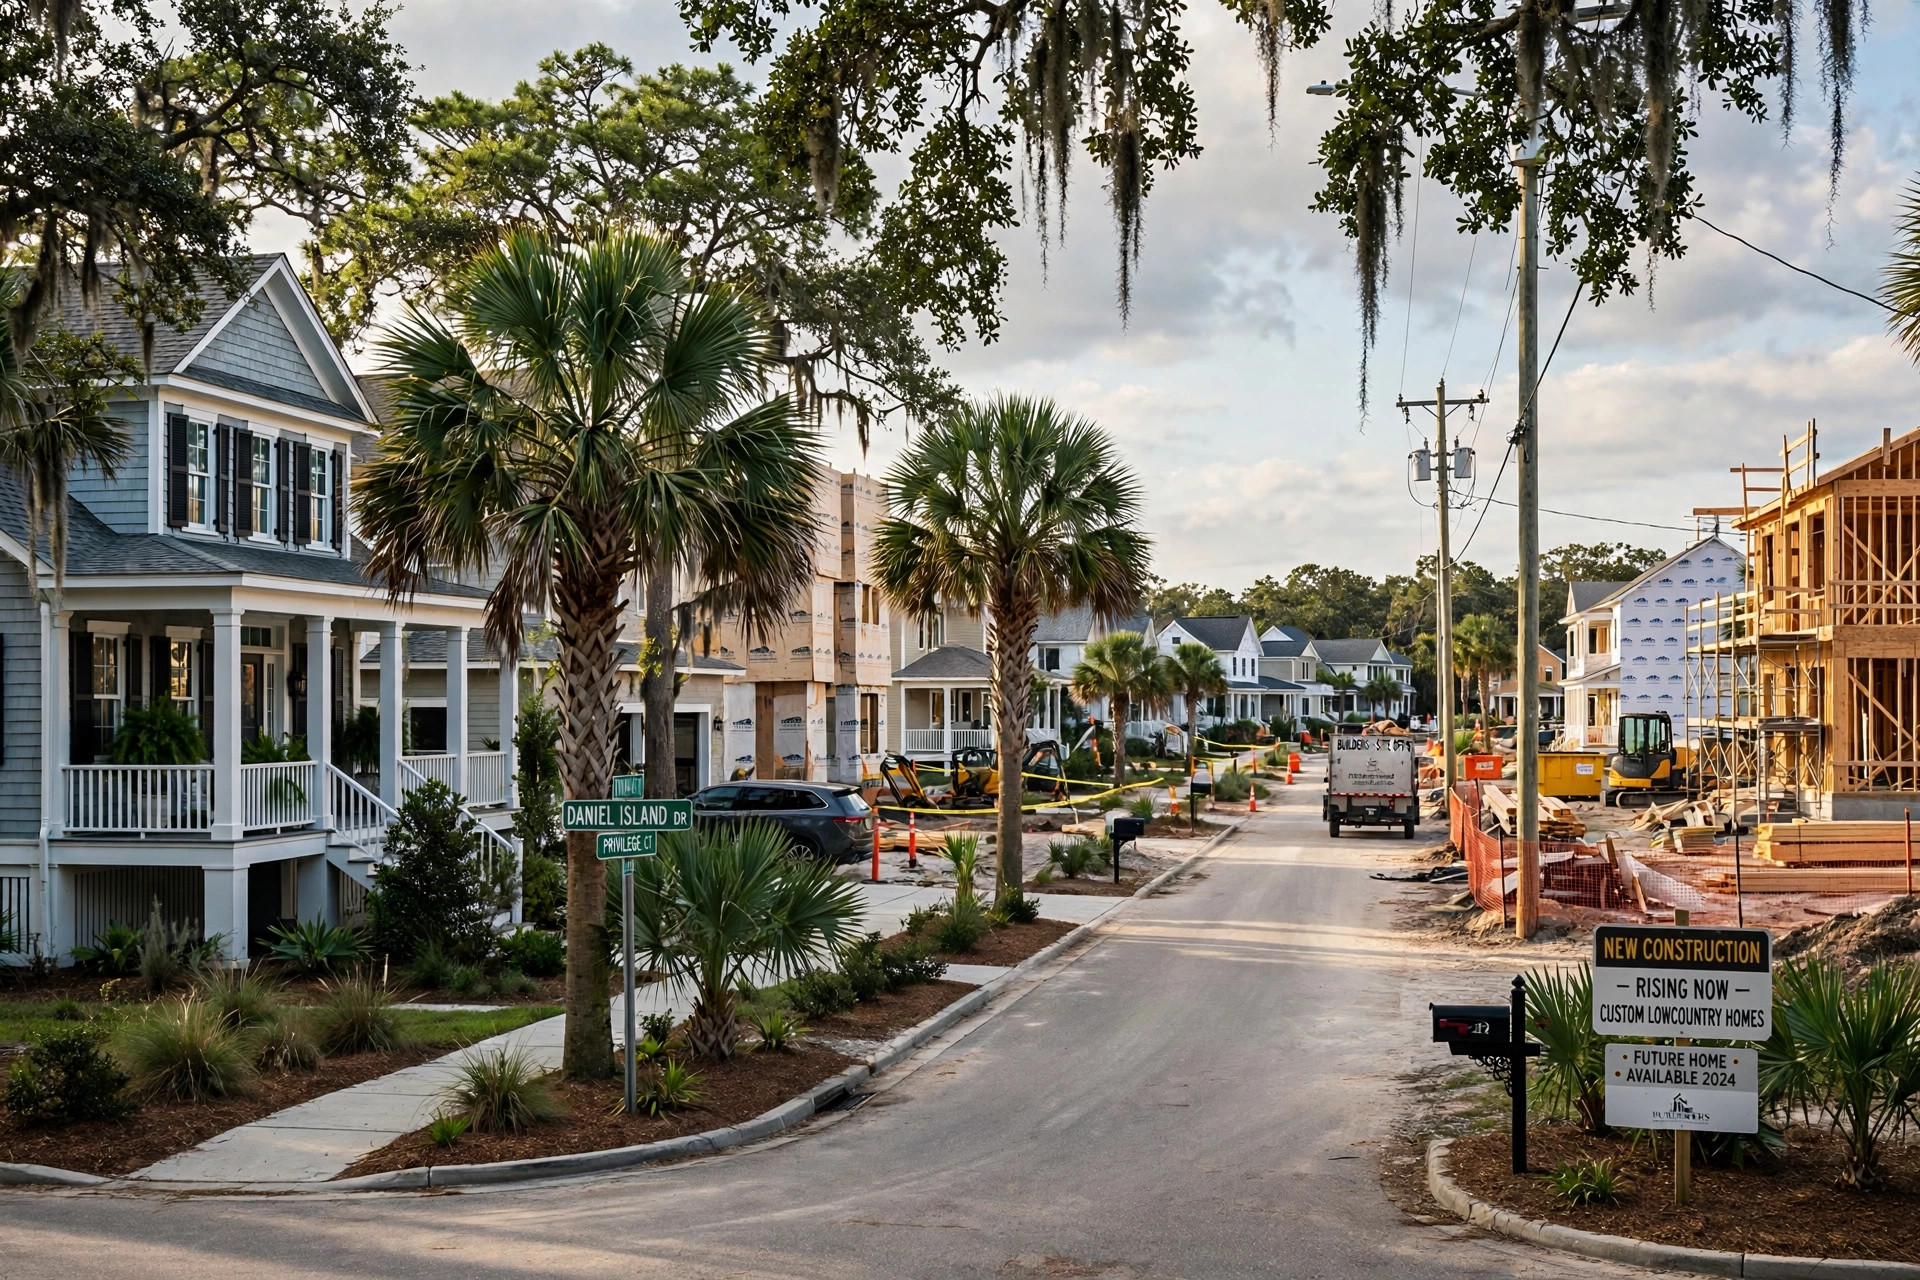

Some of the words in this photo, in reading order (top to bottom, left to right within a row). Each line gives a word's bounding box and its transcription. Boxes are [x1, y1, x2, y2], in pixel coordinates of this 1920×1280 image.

[567, 805, 615, 826] DANIEL
[620, 805, 668, 826] ISLAND
[673, 811, 688, 826] DR
[603, 835, 642, 854] PRIVILEGE
[643, 835, 653, 850] CT
[1604, 937, 1637, 960] NEW
[1643, 937, 1760, 964] CONSTRUCTION
[1636, 977, 1688, 999] RISING
[1694, 979, 1729, 1000] NOW
[1600, 1004, 1645, 1024] CUSTOM
[1648, 1005, 1723, 1027] LOWCOUNTRY
[1725, 1009, 1765, 1028] HOMES
[1634, 1050, 1685, 1067] FUTURE
[1689, 1053, 1727, 1069] HOME
[1626, 1068, 1699, 1086] AVAILABLE
[1702, 1072, 1736, 1087] 2024
